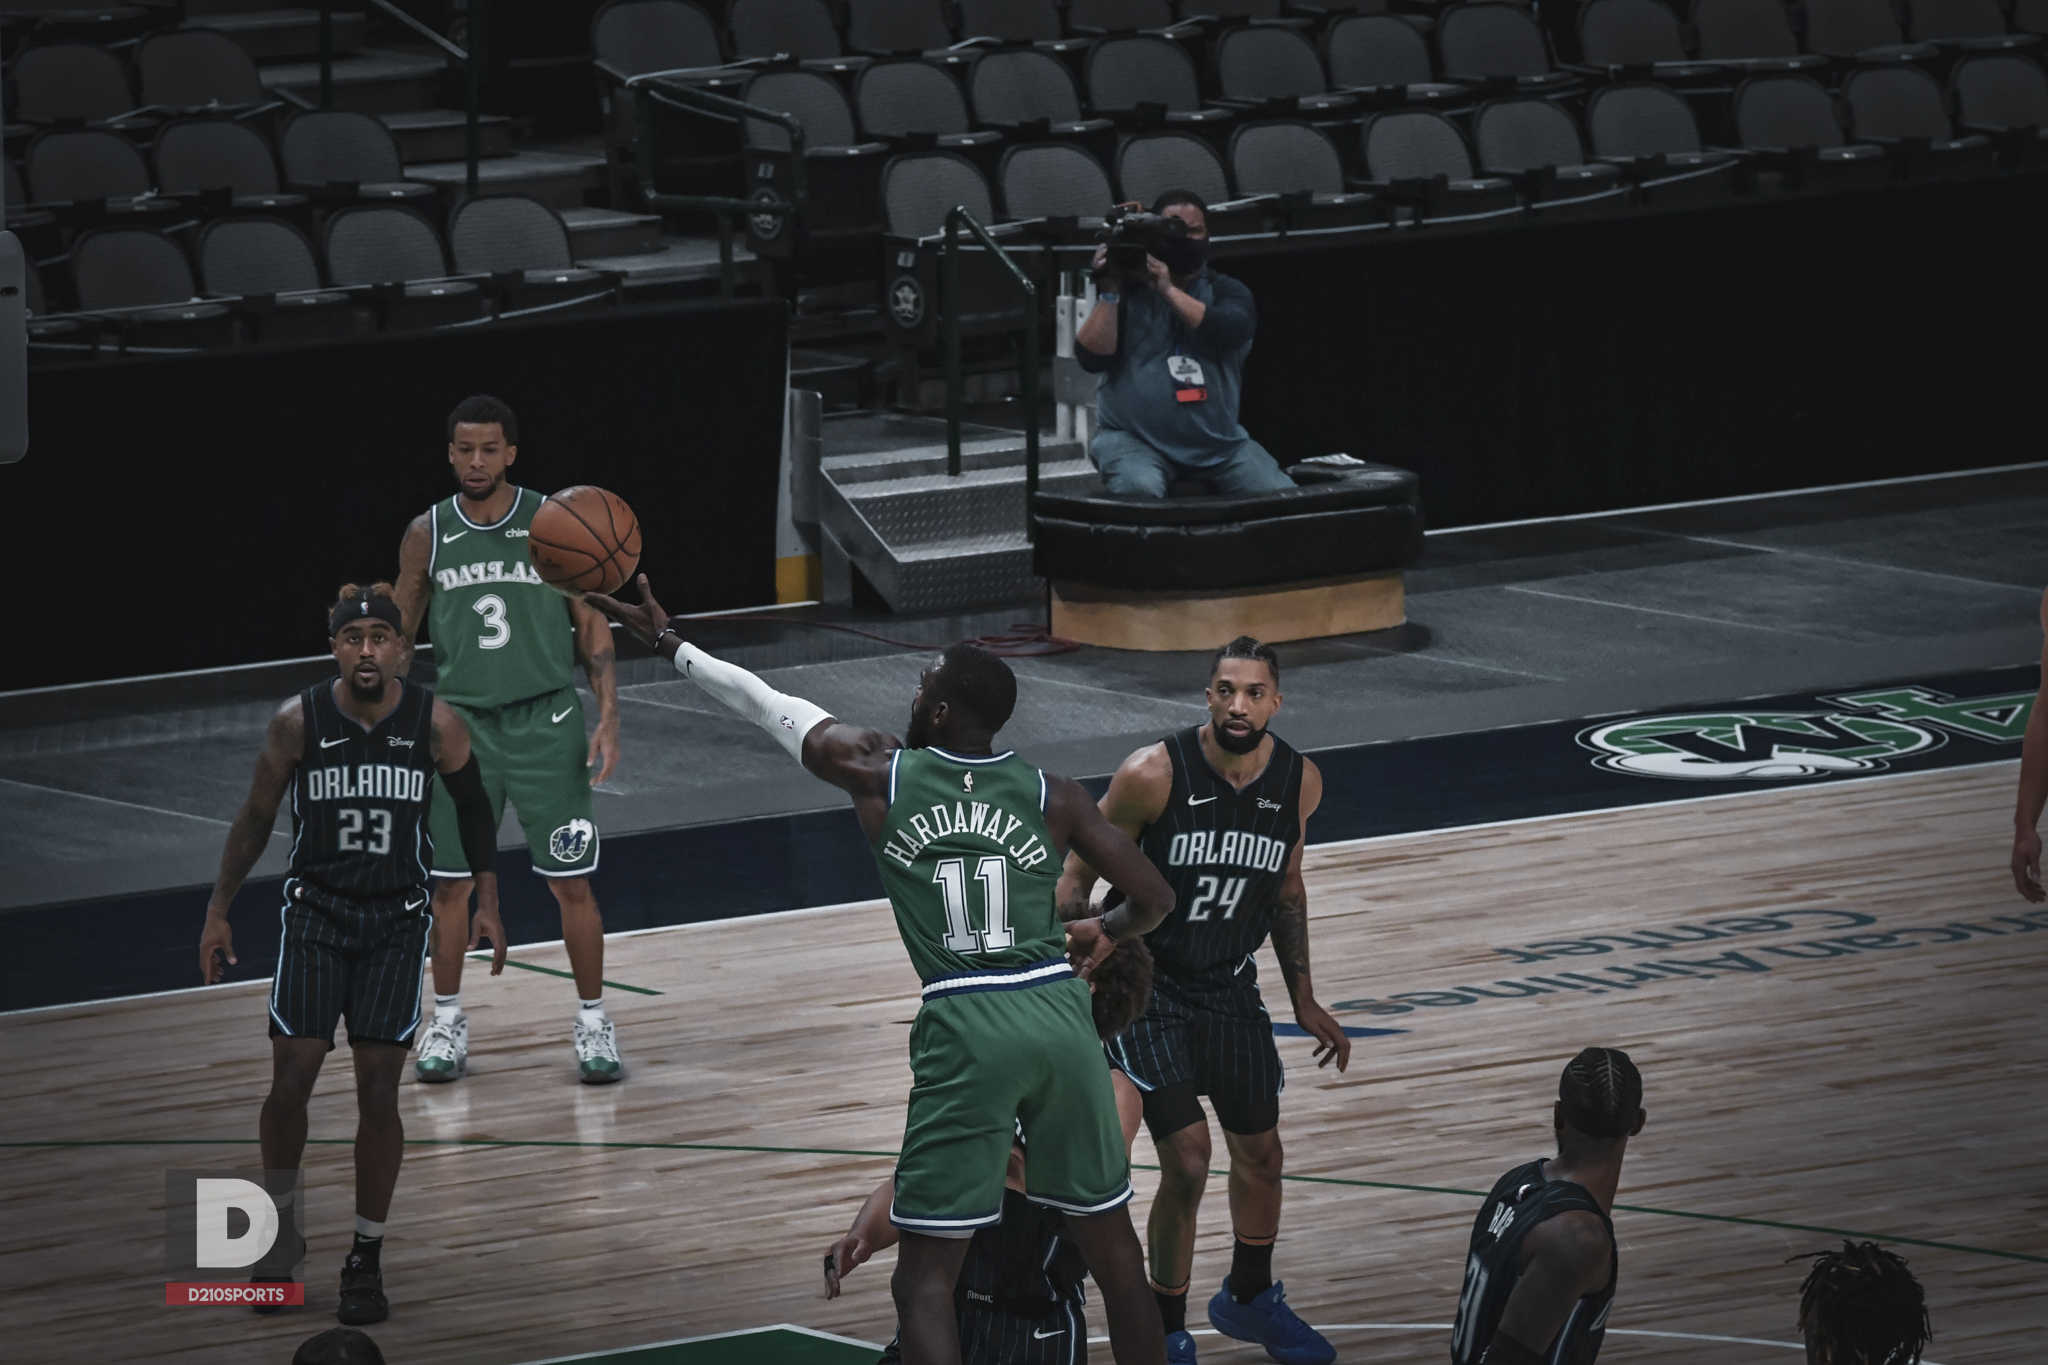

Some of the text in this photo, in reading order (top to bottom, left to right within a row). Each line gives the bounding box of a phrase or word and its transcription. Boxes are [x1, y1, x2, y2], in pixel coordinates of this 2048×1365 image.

[505, 528, 530, 538] chim
[473, 594, 511, 649] 3
[387, 736, 415, 749] Disney
[308, 763, 425, 802] ORLANDO
[1256, 797, 1282, 812] Disney
[338, 808, 392, 855] 23
[884, 801, 1048, 870] HARDAWAY JR
[1168, 830, 1287, 873] ORLANDO
[932, 856, 1015, 954] 11
[1186, 874, 1248, 922] 24
[1494, 909, 1877, 964] Center
[1331, 951, 1772, 1014] Airlines
